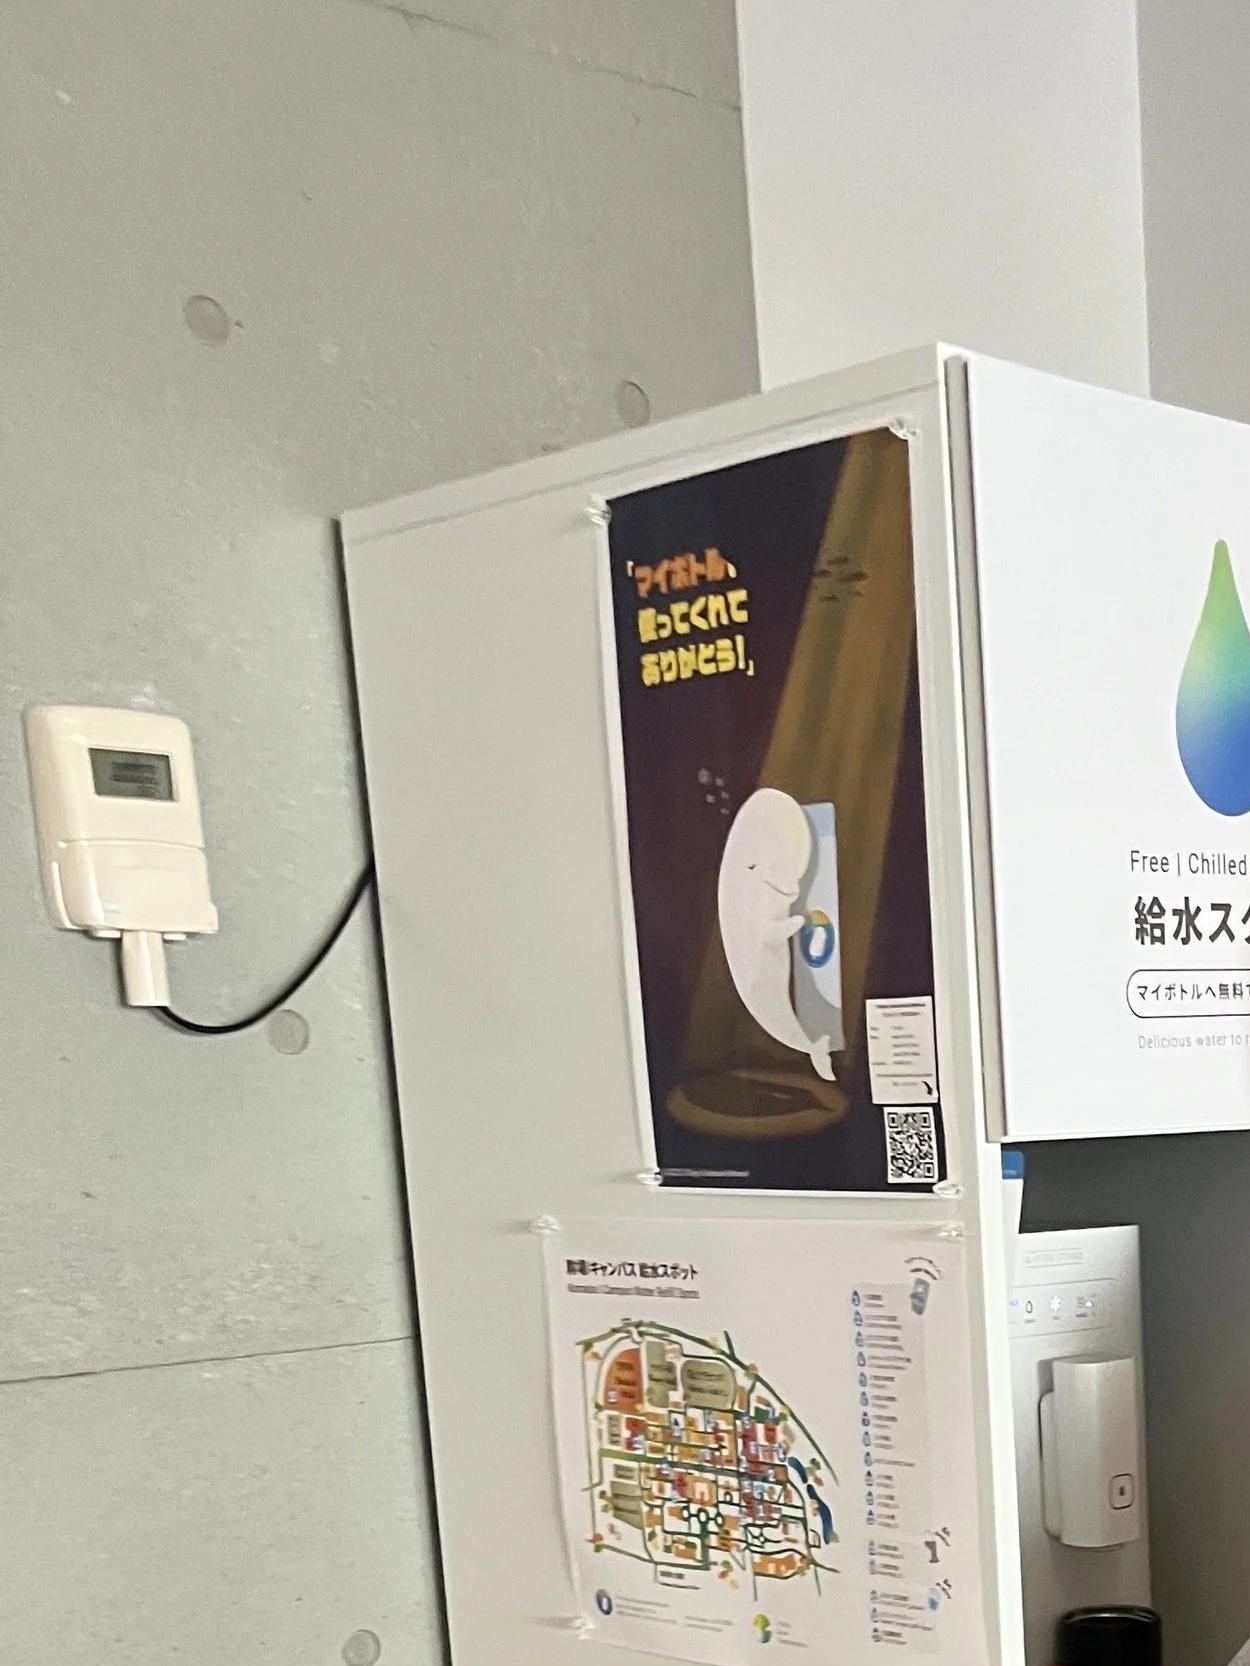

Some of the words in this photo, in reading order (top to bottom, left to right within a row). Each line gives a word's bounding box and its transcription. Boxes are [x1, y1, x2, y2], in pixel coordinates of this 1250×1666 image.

[1131, 850, 1169, 872] Free
[1188, 853, 1247, 876] Chilled
[1138, 1035, 1191, 1049] Delicious
[1196, 1035, 1226, 1047] water
[1231, 1034, 1242, 1046] to
